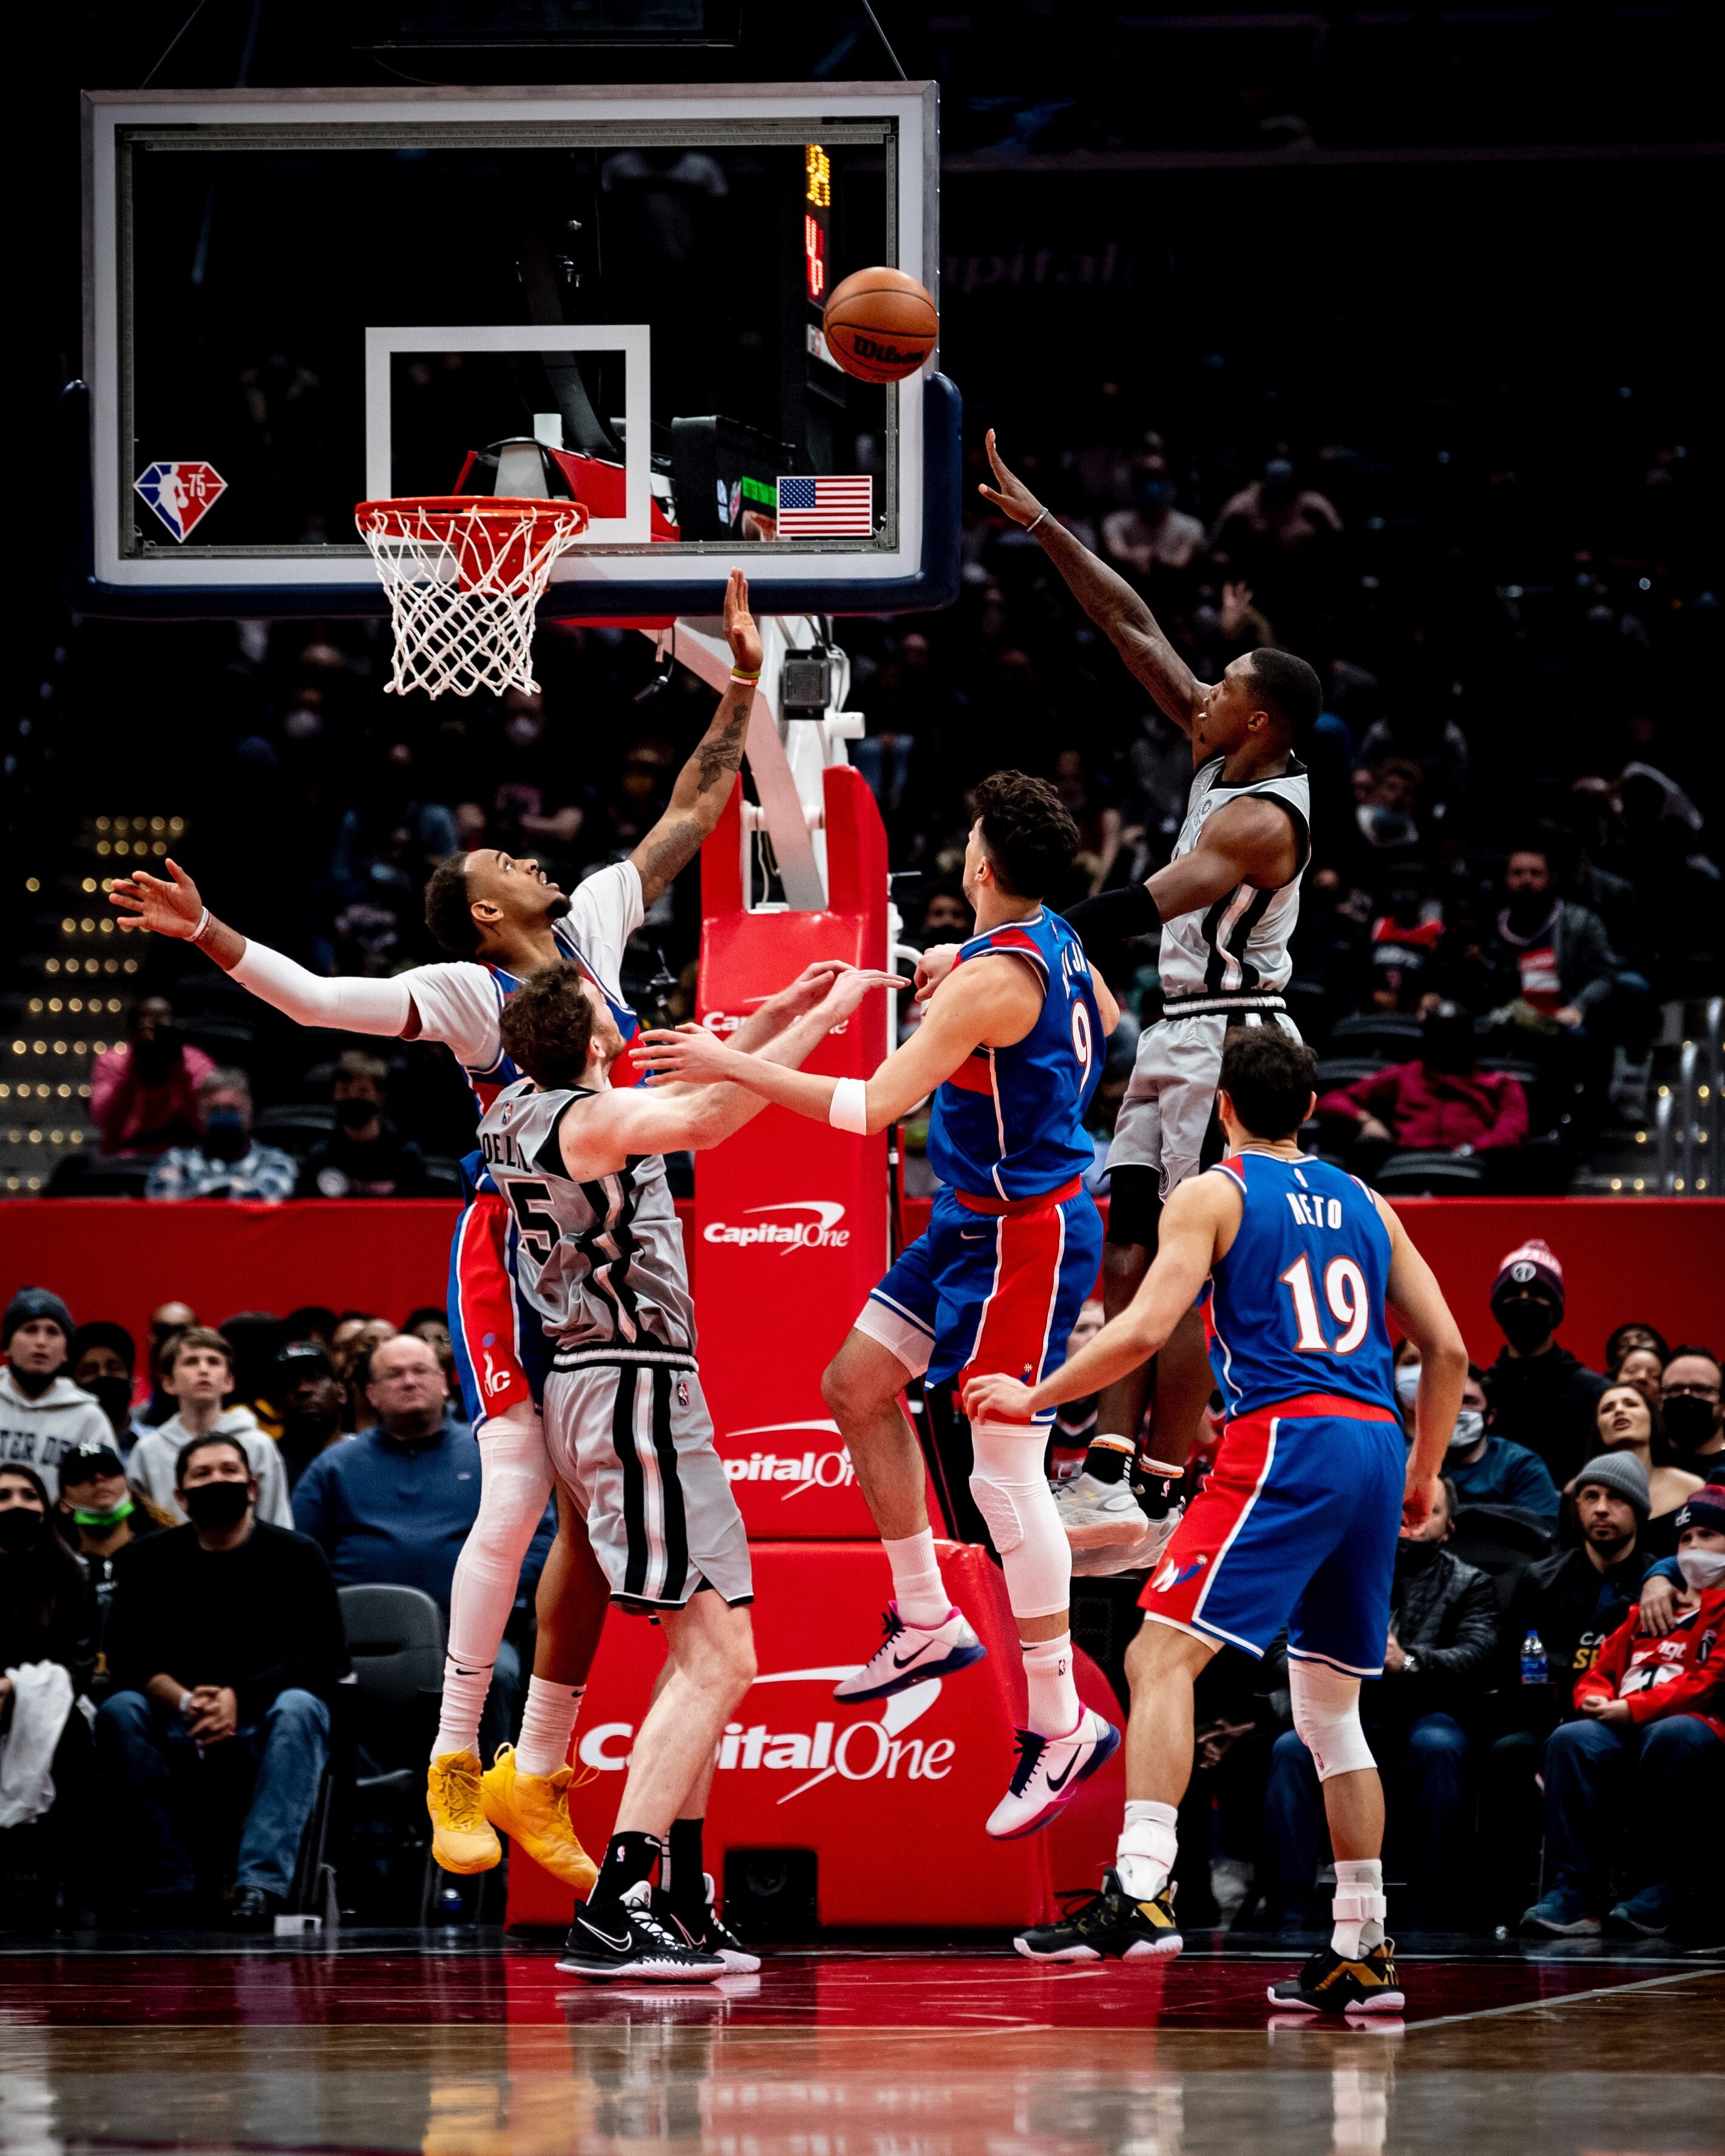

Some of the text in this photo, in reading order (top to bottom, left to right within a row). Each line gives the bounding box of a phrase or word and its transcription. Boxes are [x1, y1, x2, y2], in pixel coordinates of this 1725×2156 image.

[854, 334, 925, 363] Wilson
[188, 473, 206, 498] 75
[1071, 998, 1092, 1096] 9
[1286, 1191, 1342, 1229] NETO
[1277, 1250, 1370, 1356] 19
